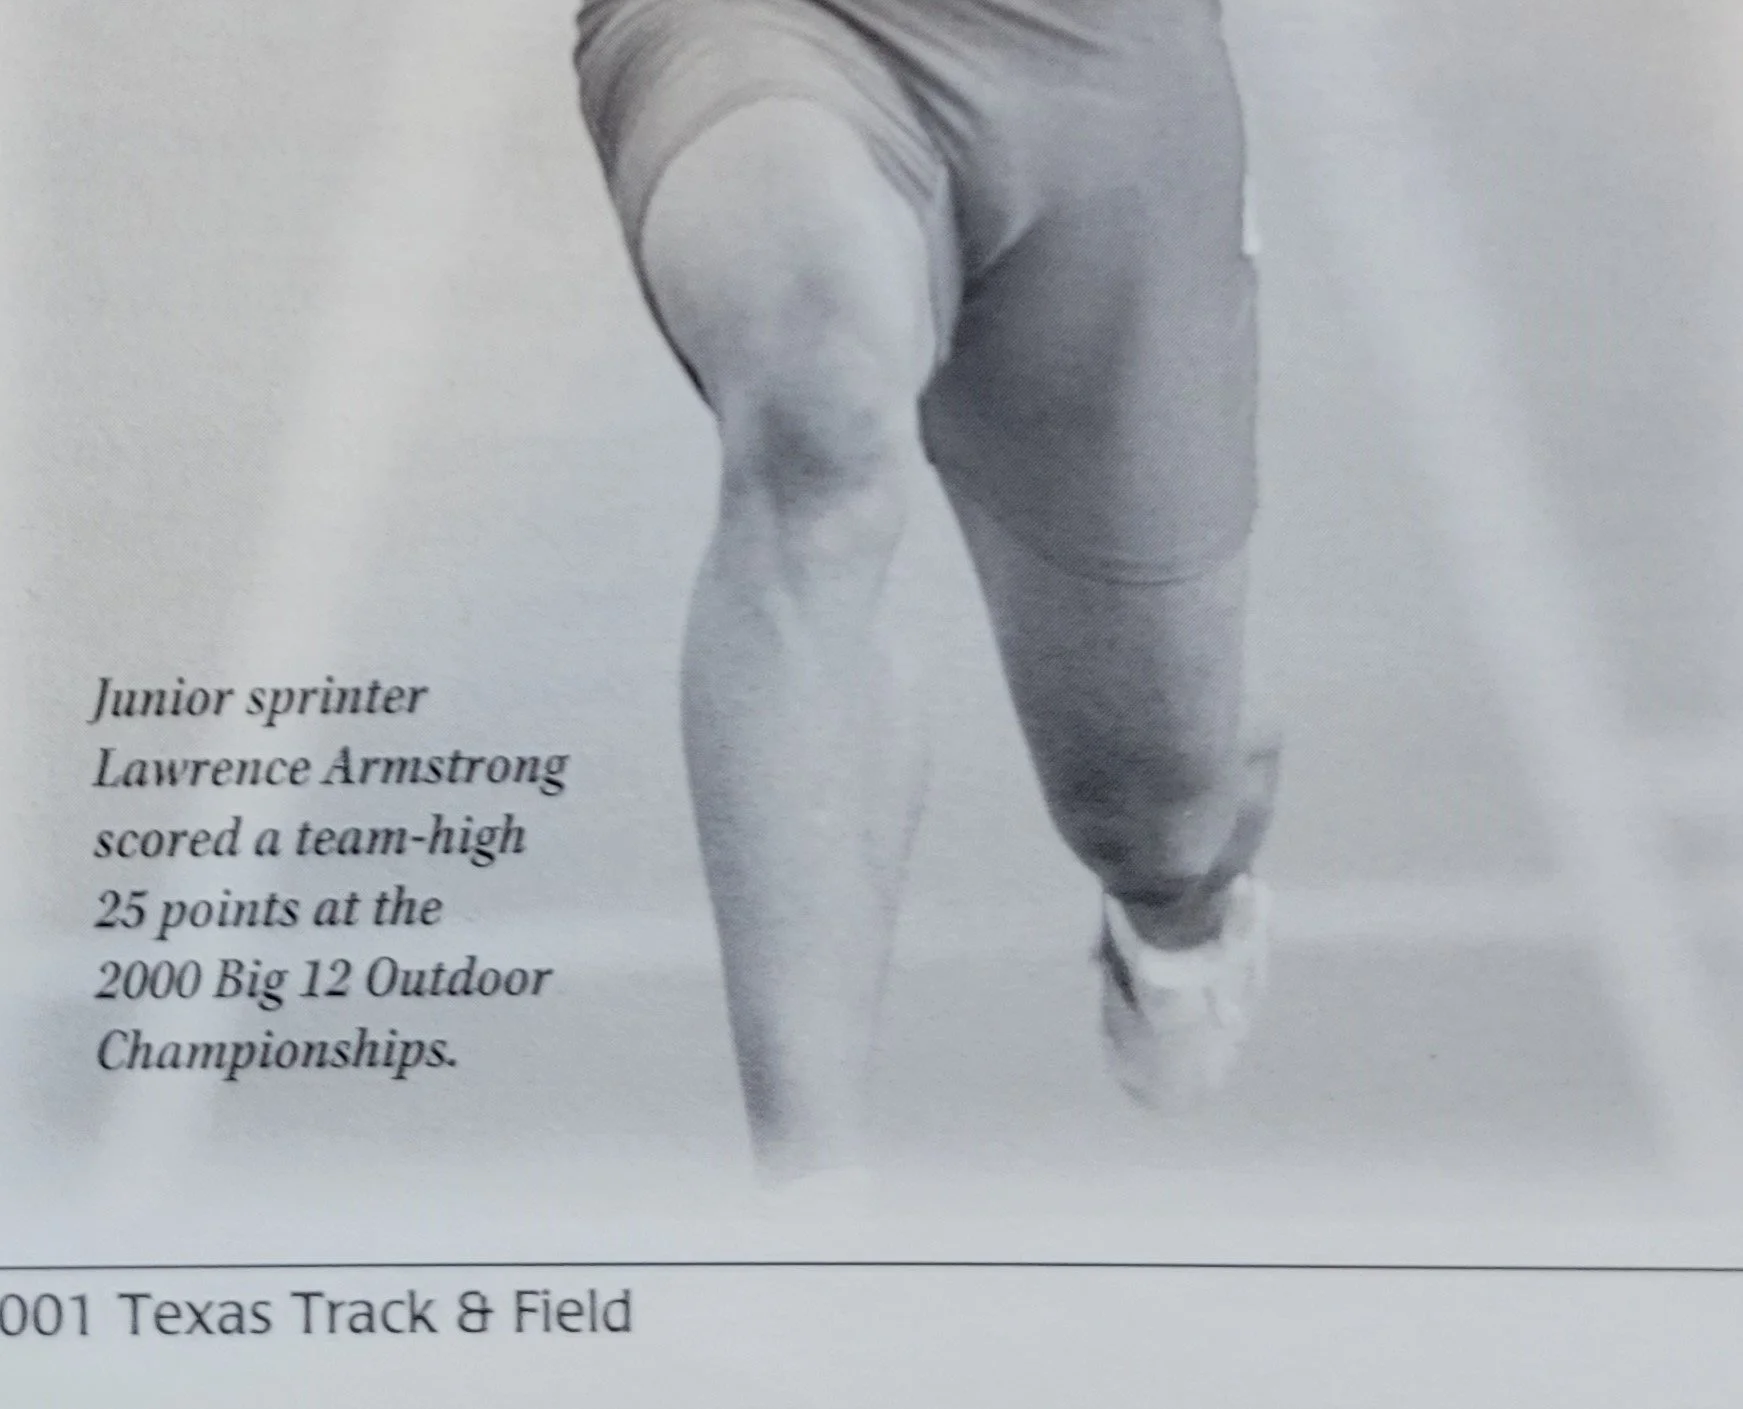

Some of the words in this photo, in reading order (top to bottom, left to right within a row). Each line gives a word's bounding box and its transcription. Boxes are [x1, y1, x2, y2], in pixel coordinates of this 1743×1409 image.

[86, 676, 235, 724] Junior
[245, 675, 430, 728] sprinter
[92, 747, 311, 789] Lawrence
[319, 745, 570, 797] Armstrong
[93, 815, 243, 860] scored
[254, 828, 282, 858] a
[296, 812, 527, 868] team-high
[93, 889, 147, 930] 25
[154, 888, 300, 942] points
[313, 891, 362, 928] at
[373, 884, 444, 927] the
[94, 959, 203, 1001] 2000
[212, 958, 289, 1012] Big
[299, 958, 352, 999] 12
[366, 954, 555, 999] Outdoor
[96, 1026, 459, 1082] Championships.
[117, 1291, 274, 1337] Texas
[290, 1289, 438, 1336] Track
[456, 1289, 495, 1335] &
[514, 1287, 633, 1334] Field
